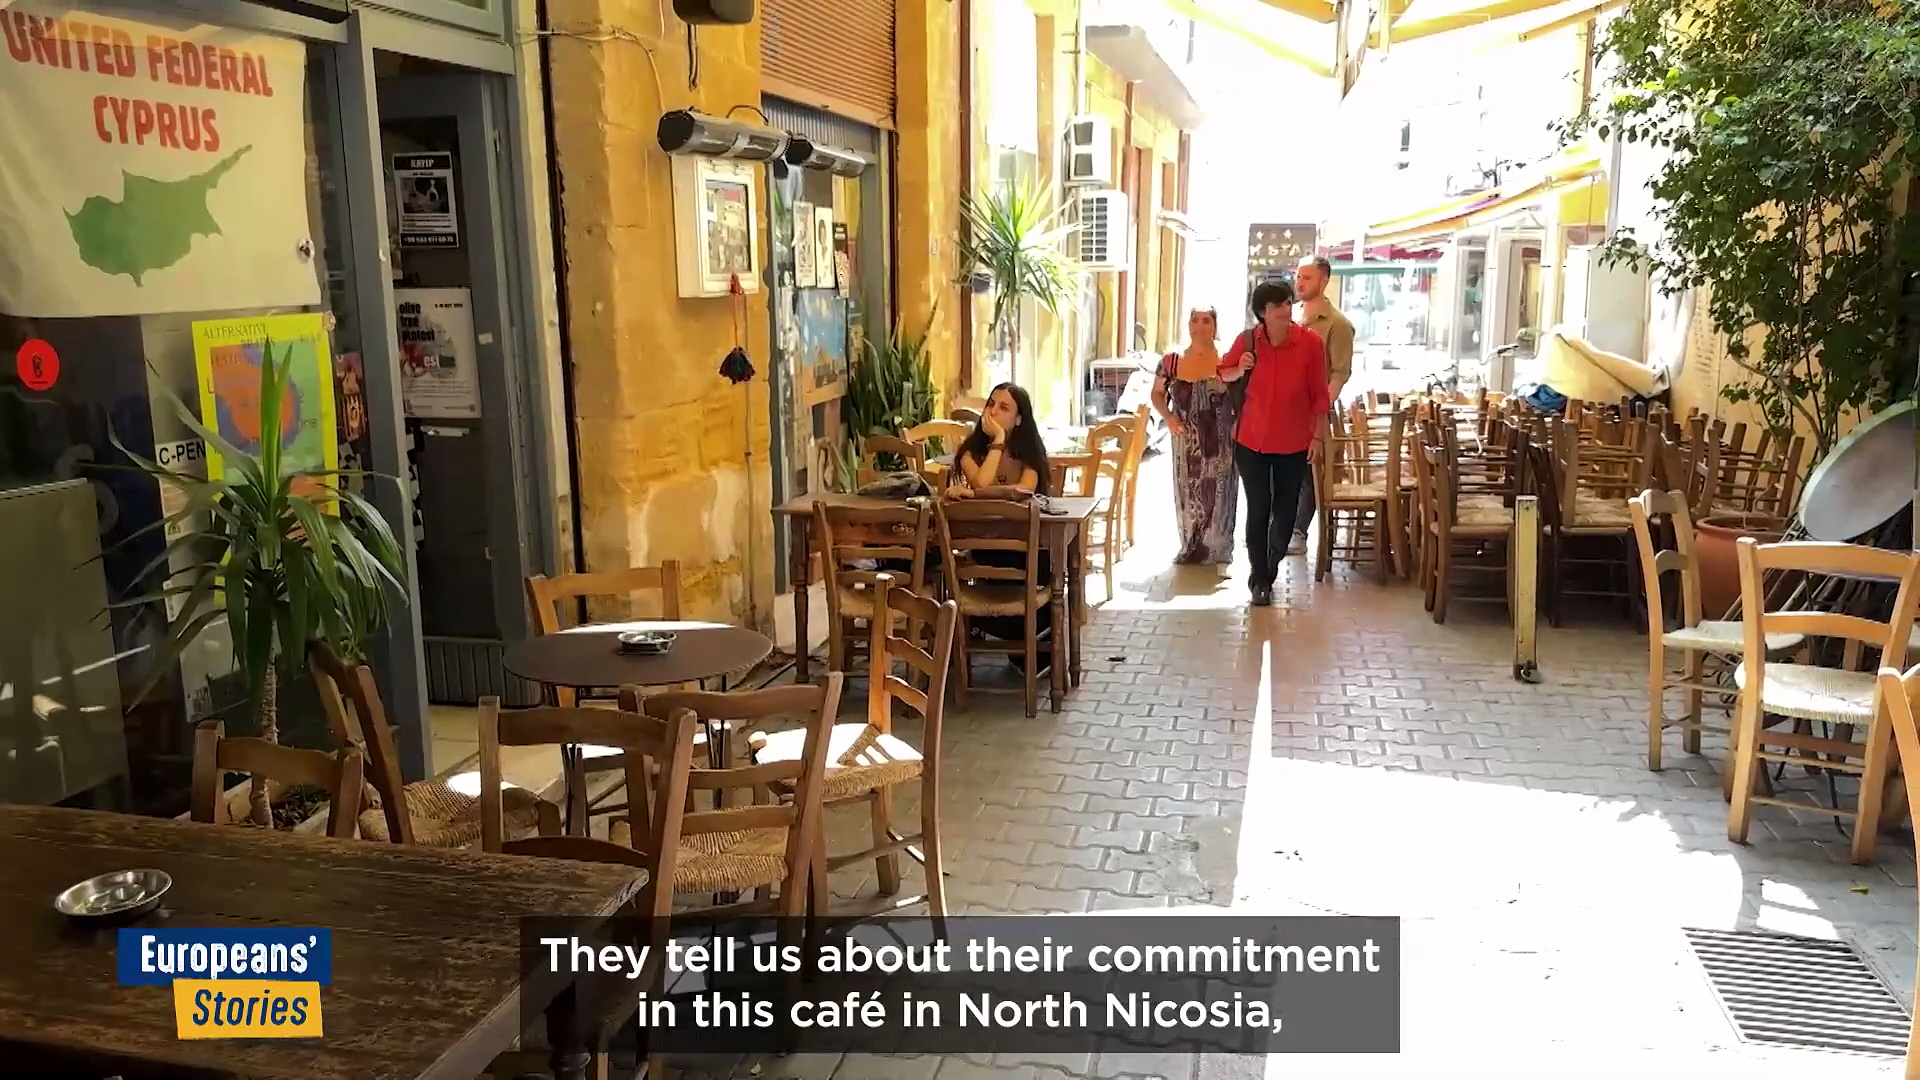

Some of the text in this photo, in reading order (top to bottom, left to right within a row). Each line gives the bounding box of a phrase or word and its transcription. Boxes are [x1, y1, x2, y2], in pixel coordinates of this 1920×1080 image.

[0, 9, 274, 97] UNITED FEDERAL
[93, 95, 220, 152] CYPRUS
[399, 302, 422, 315] olive
[159, 441, 206, 466] C-PEN
